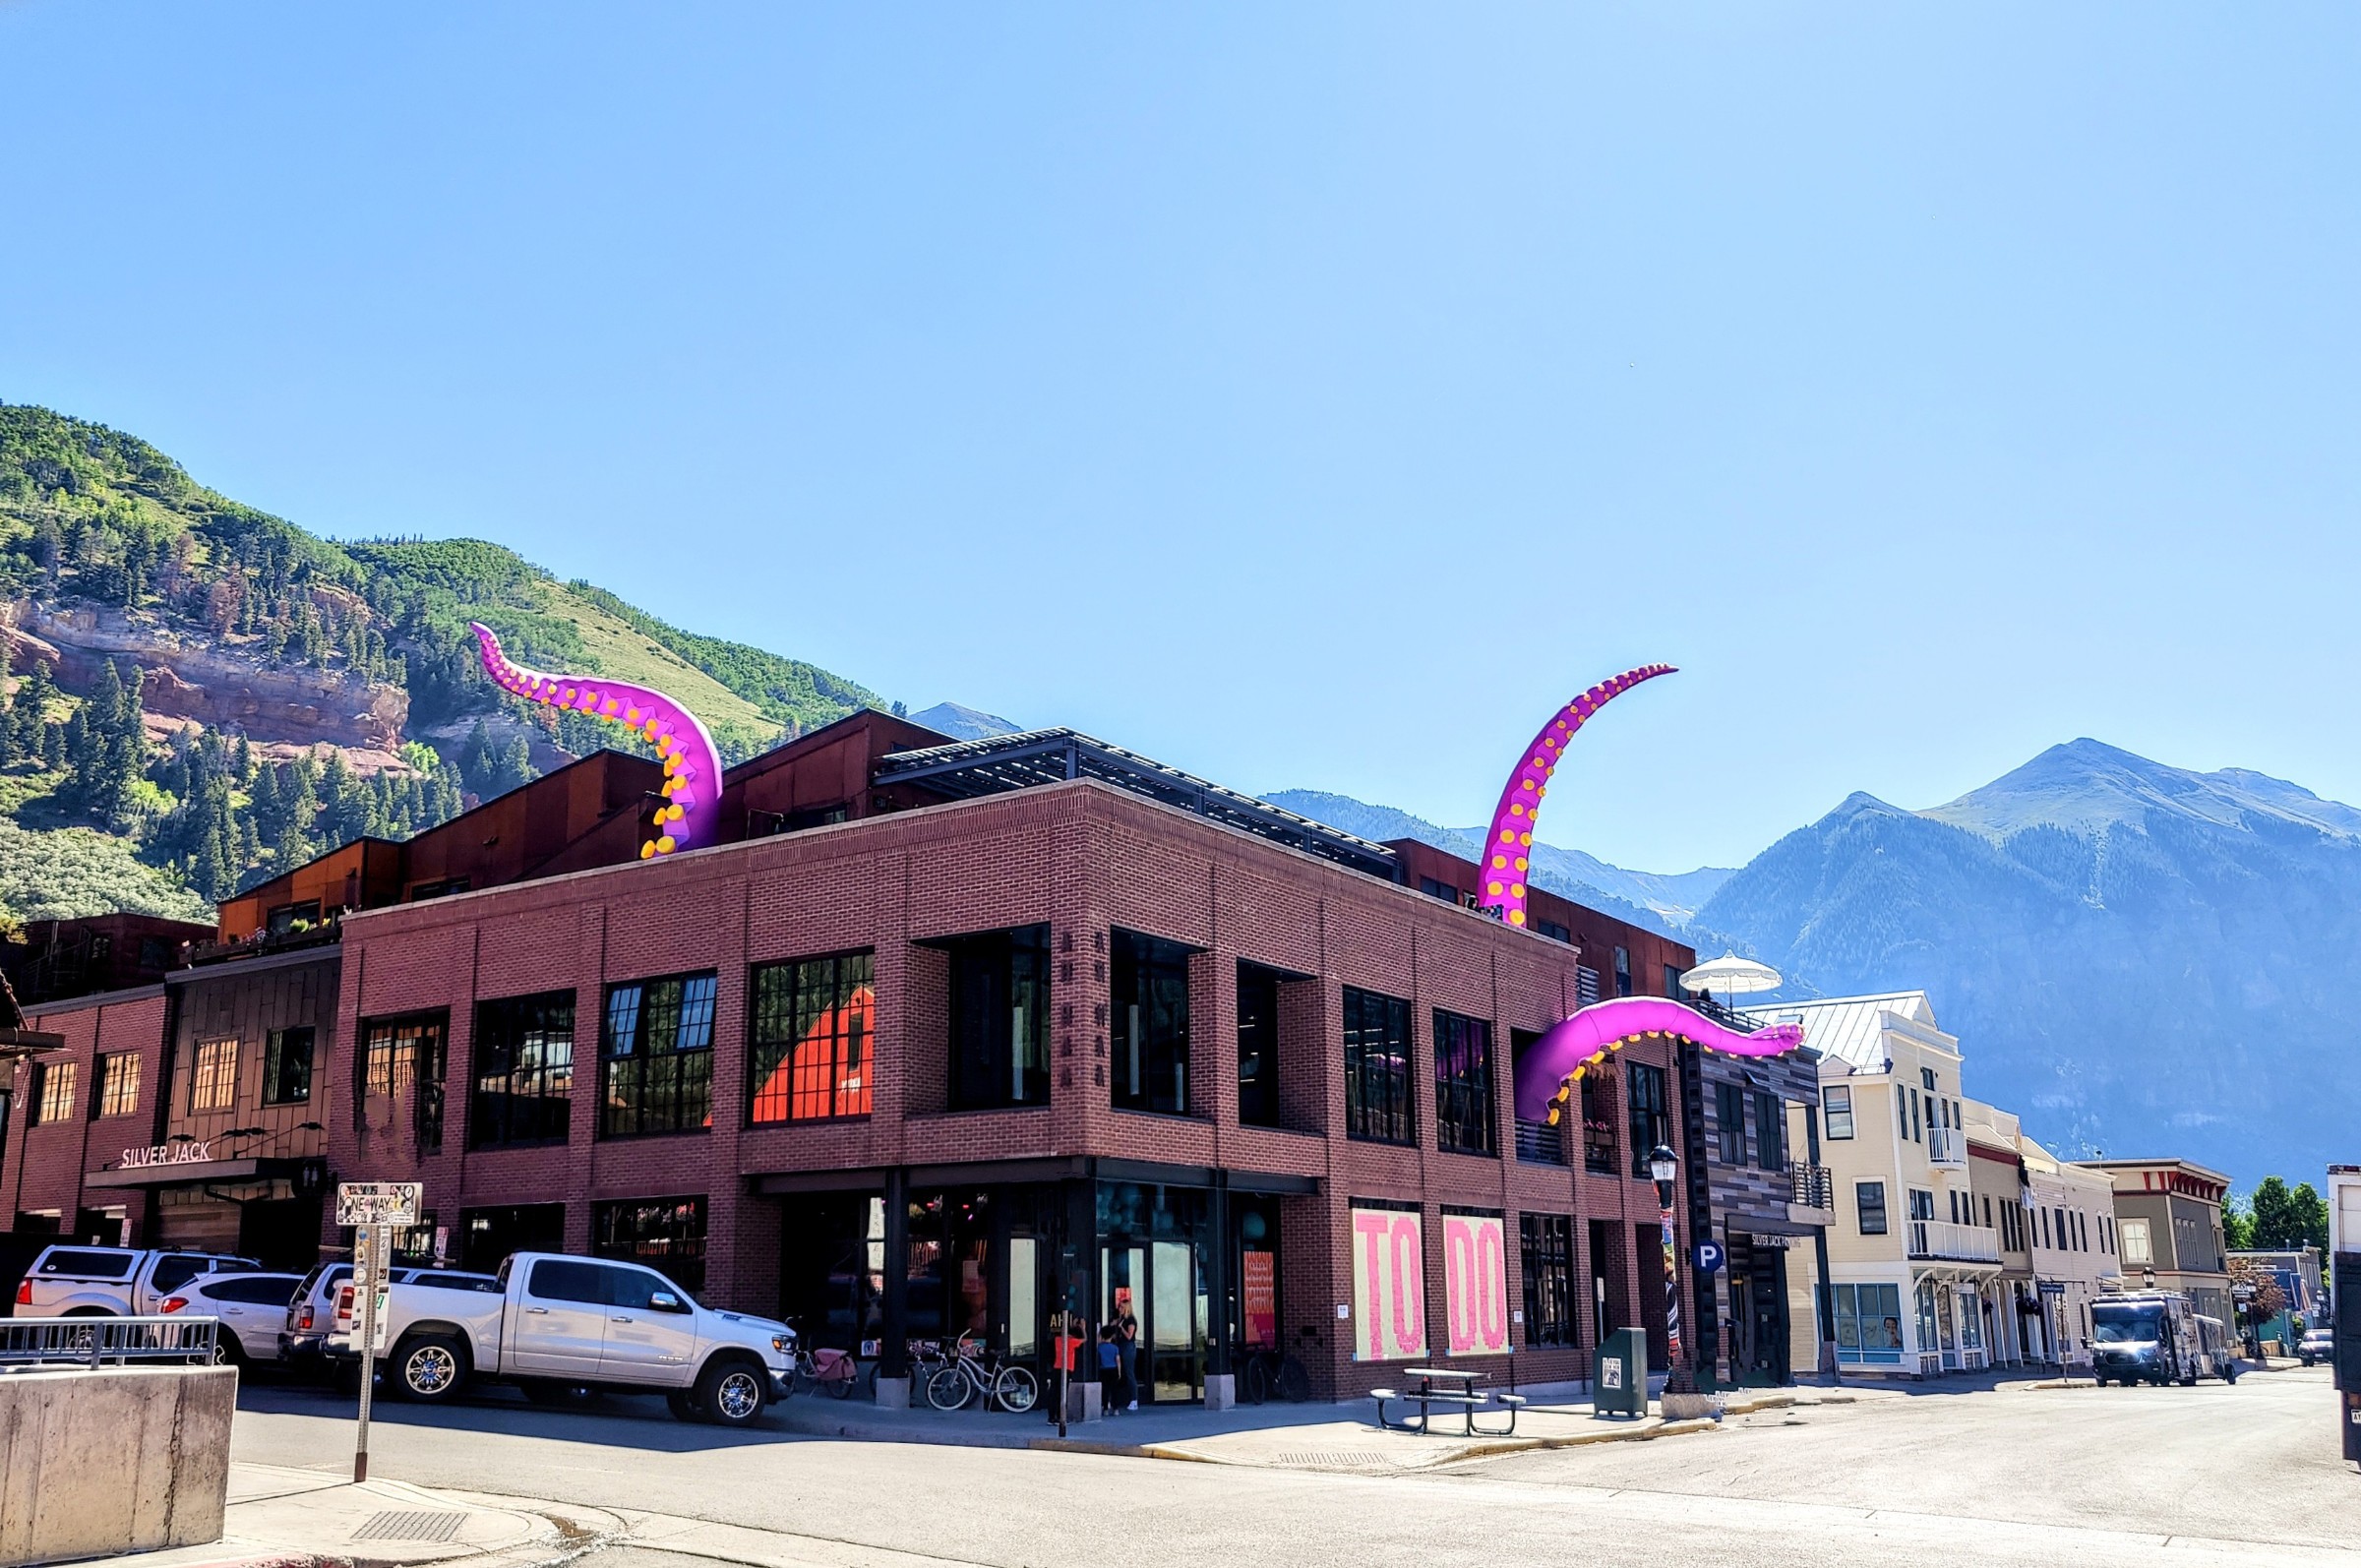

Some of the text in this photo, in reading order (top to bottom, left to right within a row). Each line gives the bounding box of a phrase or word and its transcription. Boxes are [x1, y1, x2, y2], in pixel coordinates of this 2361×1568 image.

[121, 1141, 211, 1168] SILVER JACK
[370, 1196, 392, 1212] WAY
[1700, 1245, 1717, 1267] P
[1355, 1213, 1423, 1360] TO
[1445, 1220, 1505, 1351] DO
